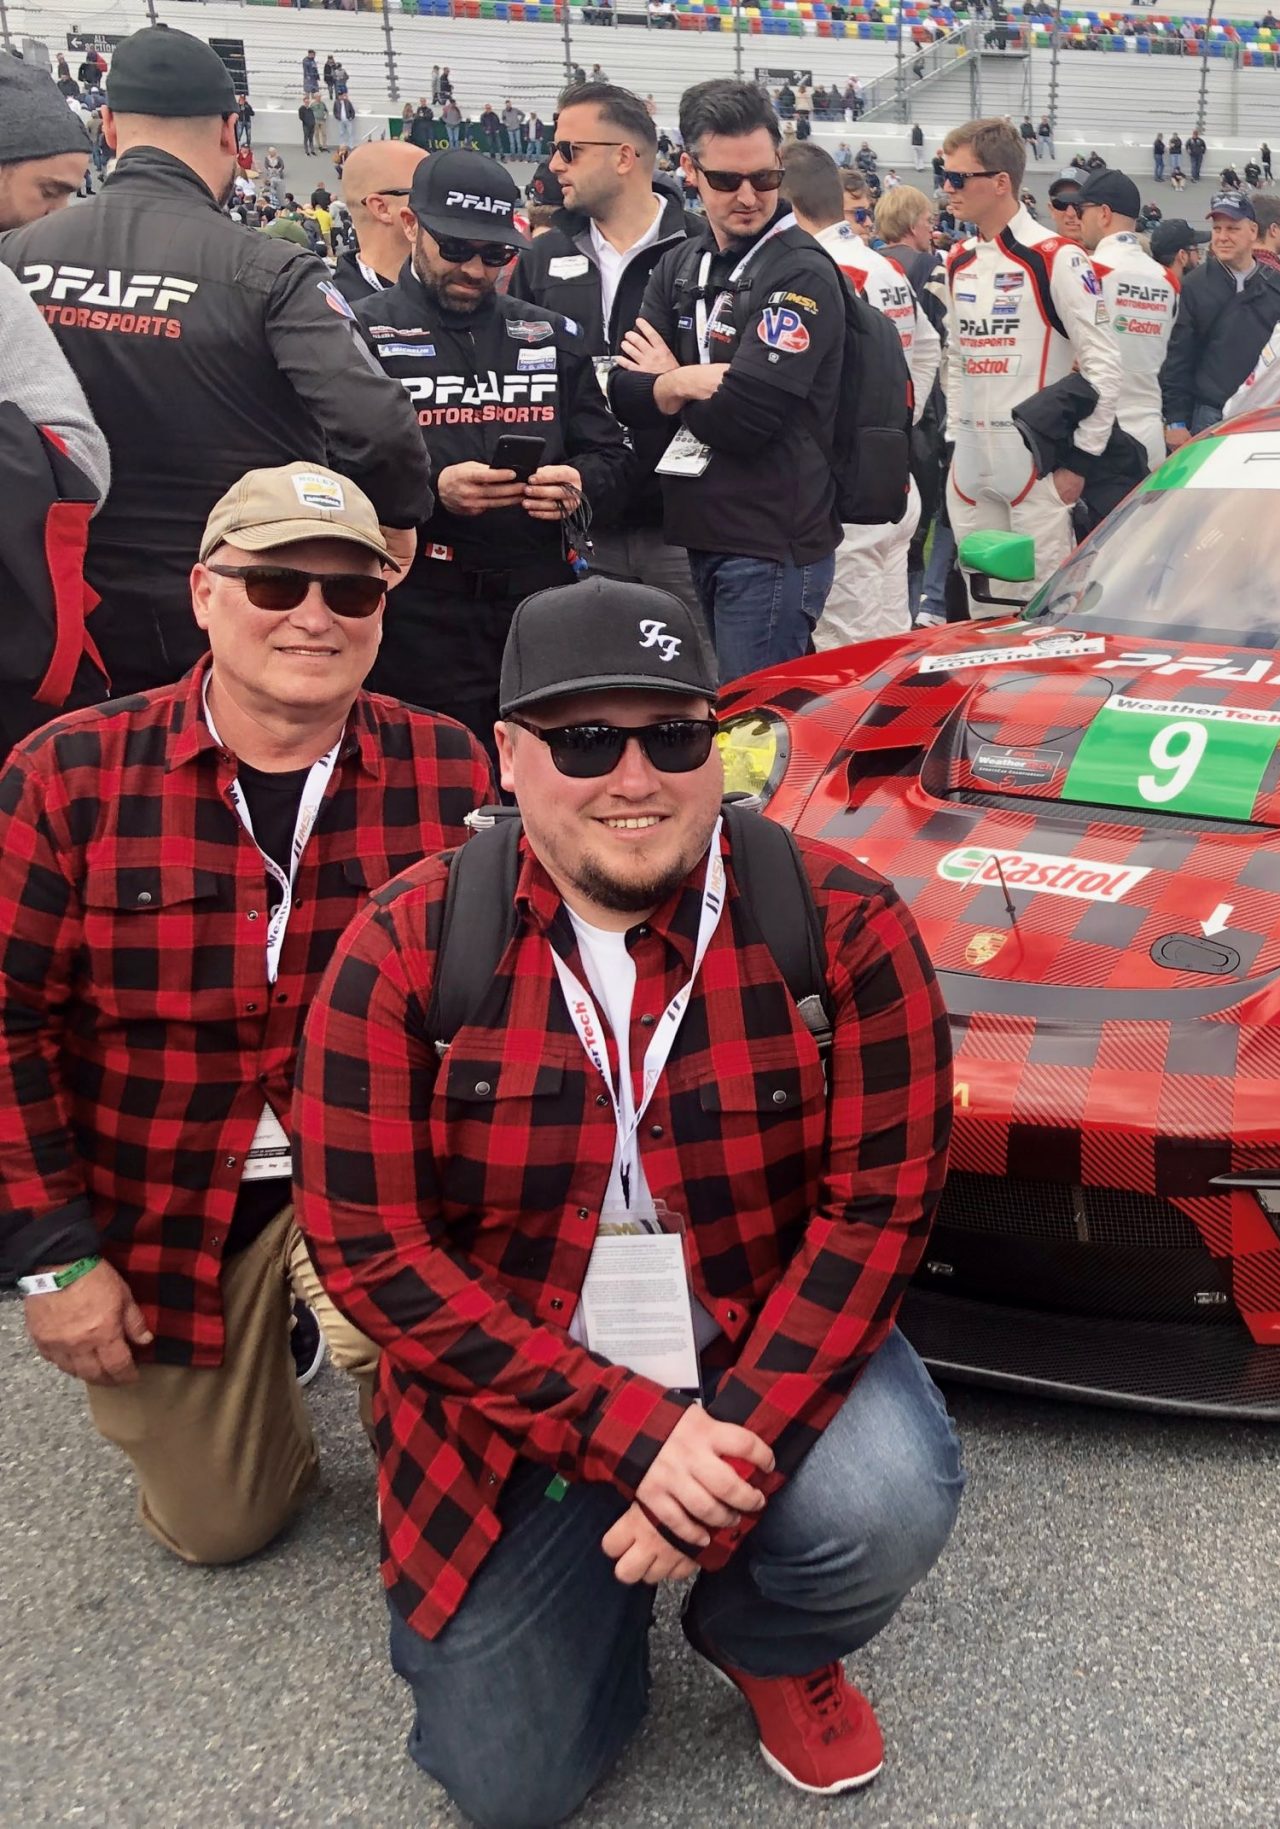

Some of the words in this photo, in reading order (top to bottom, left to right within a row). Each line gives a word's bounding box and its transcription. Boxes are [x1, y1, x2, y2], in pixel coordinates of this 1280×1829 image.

[85, 43, 117, 51] SECTION
[446, 191, 511, 215] PFAFF
[21, 264, 199, 311] PFAFF
[1117, 283, 1169, 301] PFAFF
[1116, 298, 1168, 312] MOTORSPORTS
[37, 304, 181, 339] TORSPORTS
[762, 307, 801, 346] VP
[1127, 319, 1163, 335] Castrol
[960, 337, 1017, 348] OTORSPORTS
[966, 357, 1010, 375] Castrol
[401, 371, 558, 405] PFAFF
[418, 405, 554, 426] OTORSPORTS
[1138, 721, 1209, 803] 9
[981, 855, 1130, 897] Castrol
[575, 1001, 605, 1076] erTech
